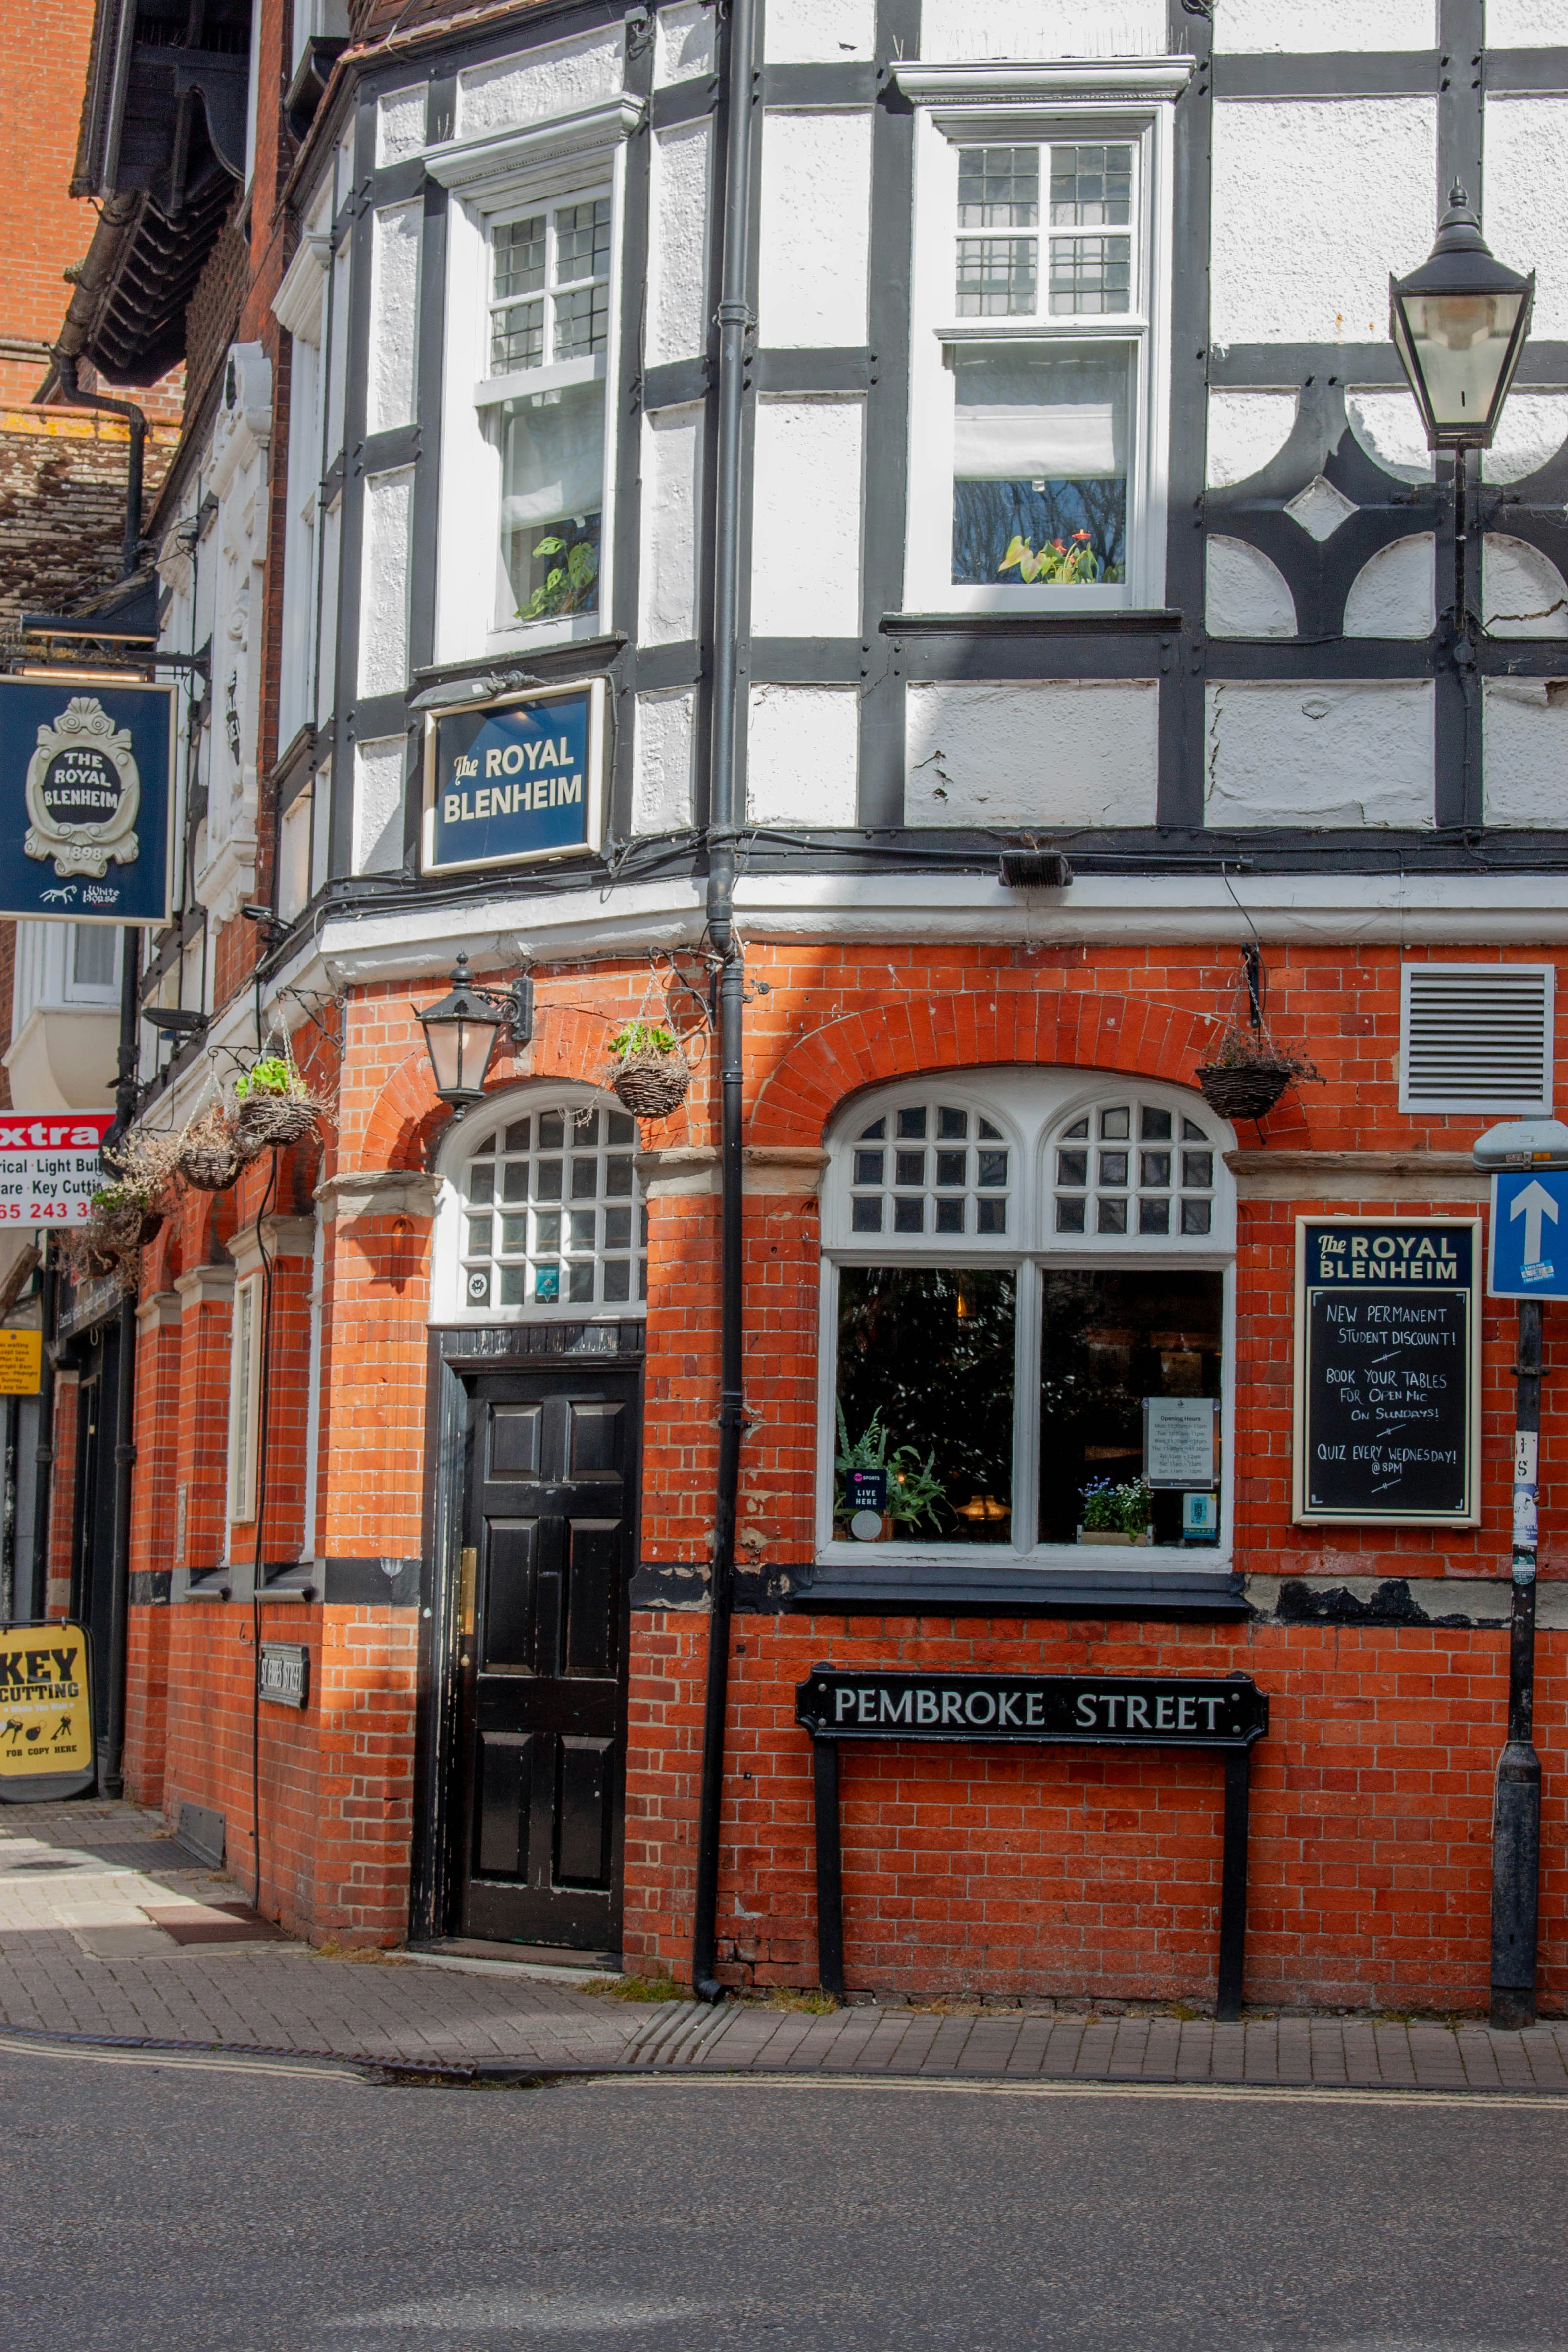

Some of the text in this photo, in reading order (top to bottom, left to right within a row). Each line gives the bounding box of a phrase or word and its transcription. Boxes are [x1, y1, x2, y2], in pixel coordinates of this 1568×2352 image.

[64, 753, 103, 768] THE
[454, 737, 574, 785] The ROYAL
[54, 769, 111, 787] ROYAL
[44, 789, 118, 809] BLENHEIM
[444, 774, 582, 823] BLENHEIM
[66, 846, 102, 861] 1898
[0, 1159, 27, 1173] ical
[37, 1158, 71, 1176] Light
[0, 1179, 103, 1198] are Key Cuttin
[30, 1203, 67, 1218] 243
[1318, 1235, 1457, 1259] The ROYAL
[1320, 1261, 1457, 1279] BLENHEIM
[1327, 1305, 1447, 1323] NEW PERMANENT
[1338, 1328, 1388, 1344] STUDENT
[1326, 1368, 1446, 1388] BOOK YOUR TABLES
[1340, 1388, 1364, 1405] FOR
[1369, 1388, 1402, 1402] OPEN
[1317, 1444, 1346, 1460] QUIZ
[1353, 1446, 1382, 1461] EVERY
[0, 1647, 78, 1686] KEY
[0, 1682, 79, 1702] CUTTING
[835, 1688, 1225, 1729] PEMBROKE STREET
[28, 1747, 49, 1756] COPY
